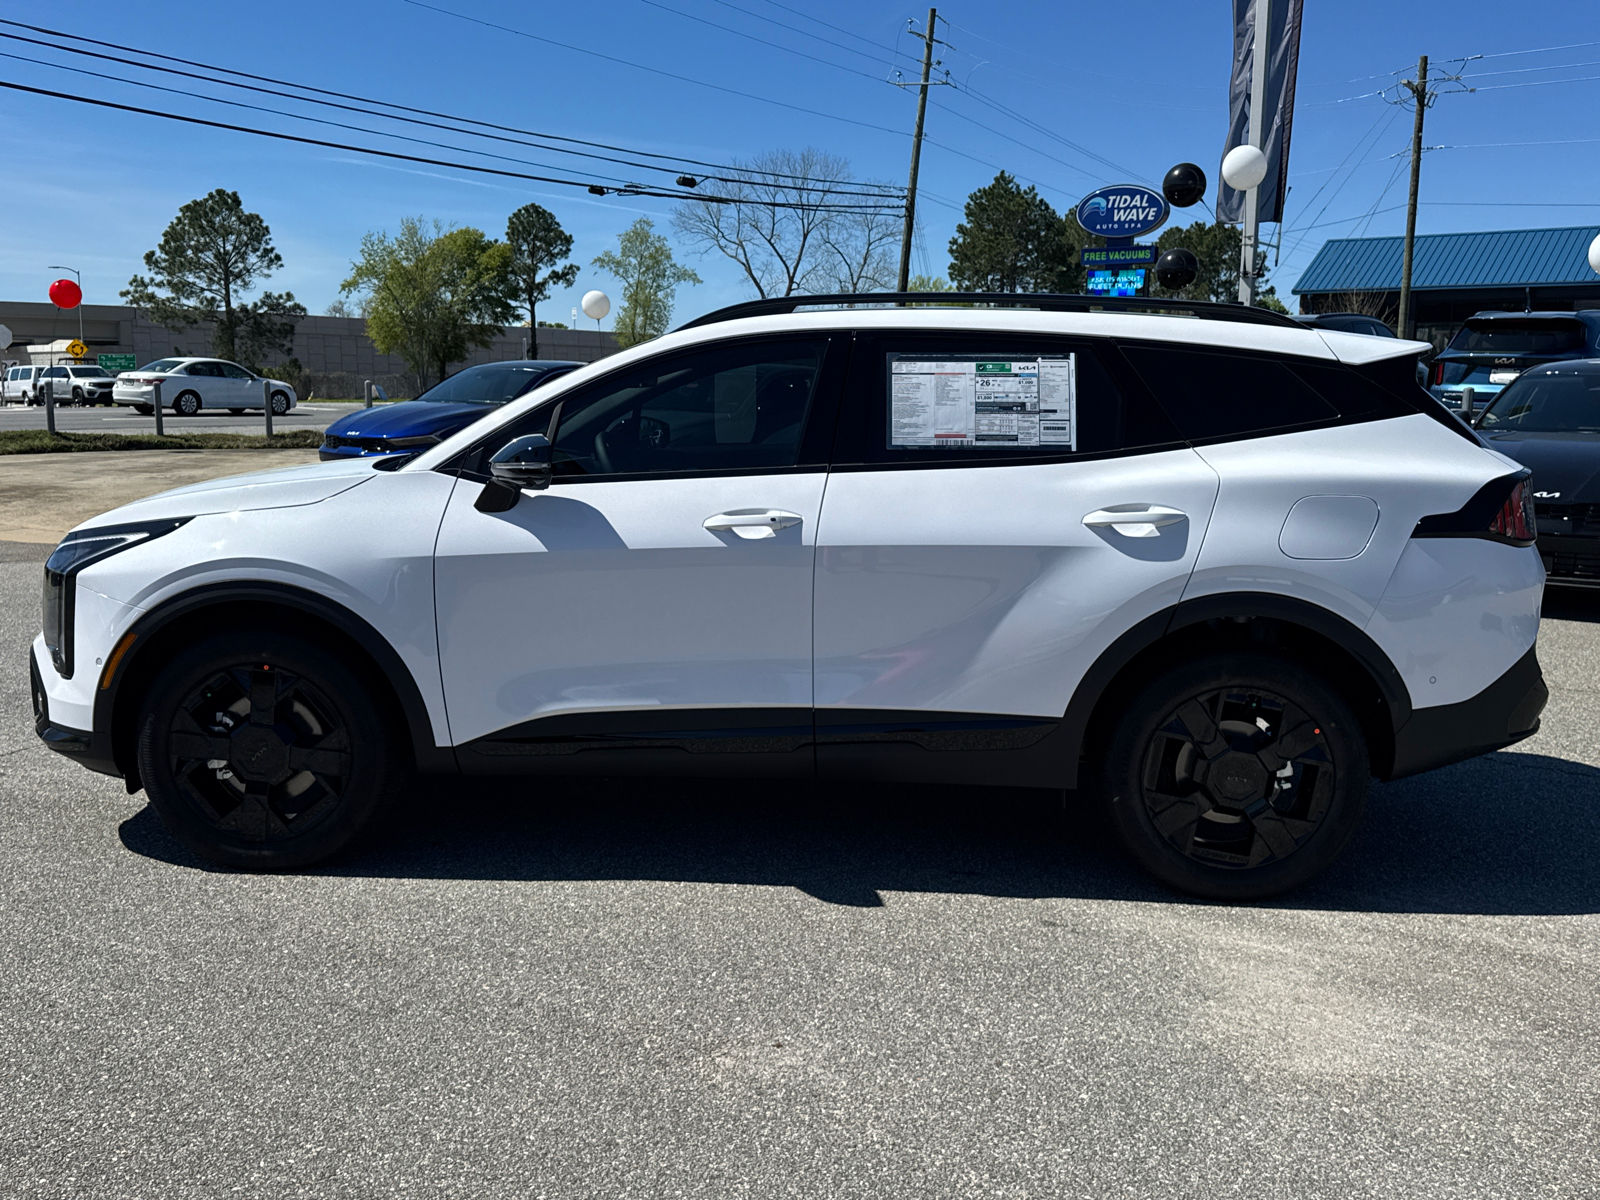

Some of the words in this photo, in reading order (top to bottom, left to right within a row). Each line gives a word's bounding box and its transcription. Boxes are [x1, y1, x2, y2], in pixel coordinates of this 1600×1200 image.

[1108, 194, 1149, 208] TIDAL
[1113, 207, 1157, 222] WAVE
[1084, 251, 1106, 261] FREE
[1108, 249, 1151, 260] VACUUMS
[980, 379, 991, 387] 26
